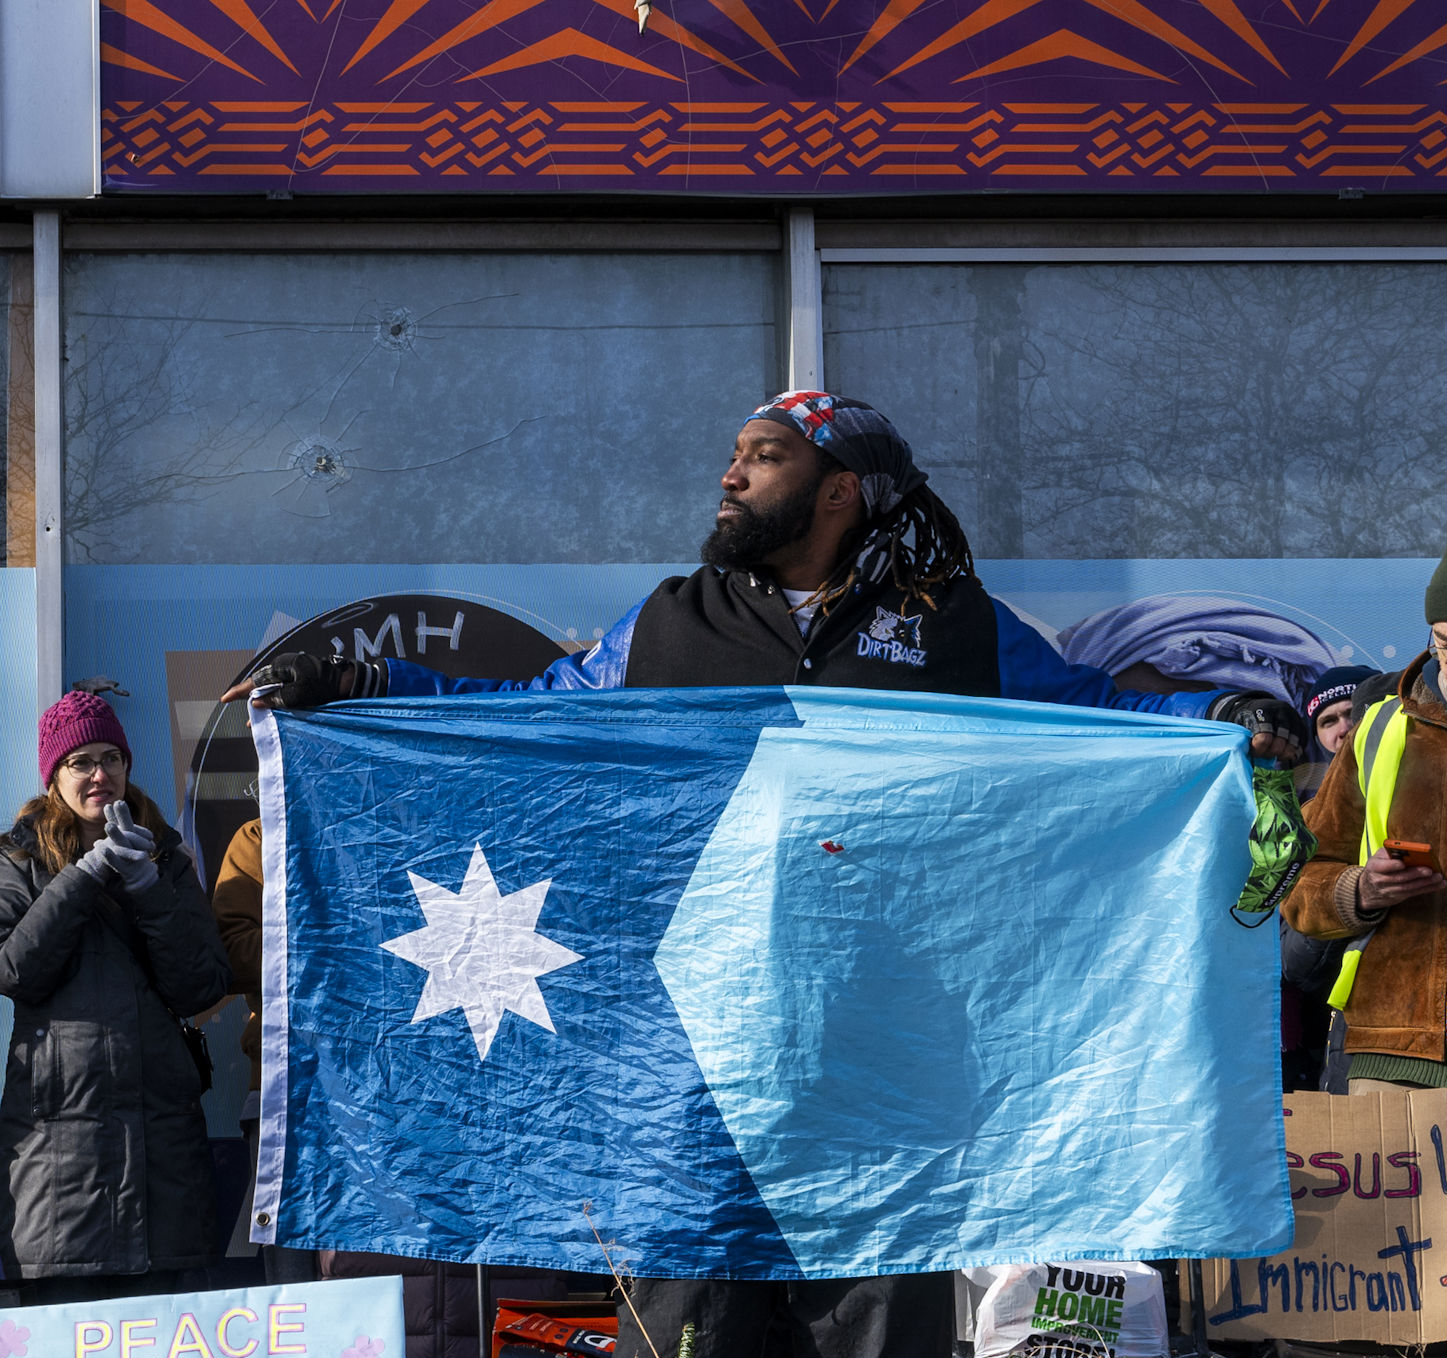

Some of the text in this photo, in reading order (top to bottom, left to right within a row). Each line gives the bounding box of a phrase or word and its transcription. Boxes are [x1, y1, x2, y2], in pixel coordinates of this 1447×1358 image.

[1046, 1265, 1128, 1299] YOUR
[1034, 1287, 1125, 1329] HOME
[1030, 1317, 1120, 1344] IMPROVEMENT
